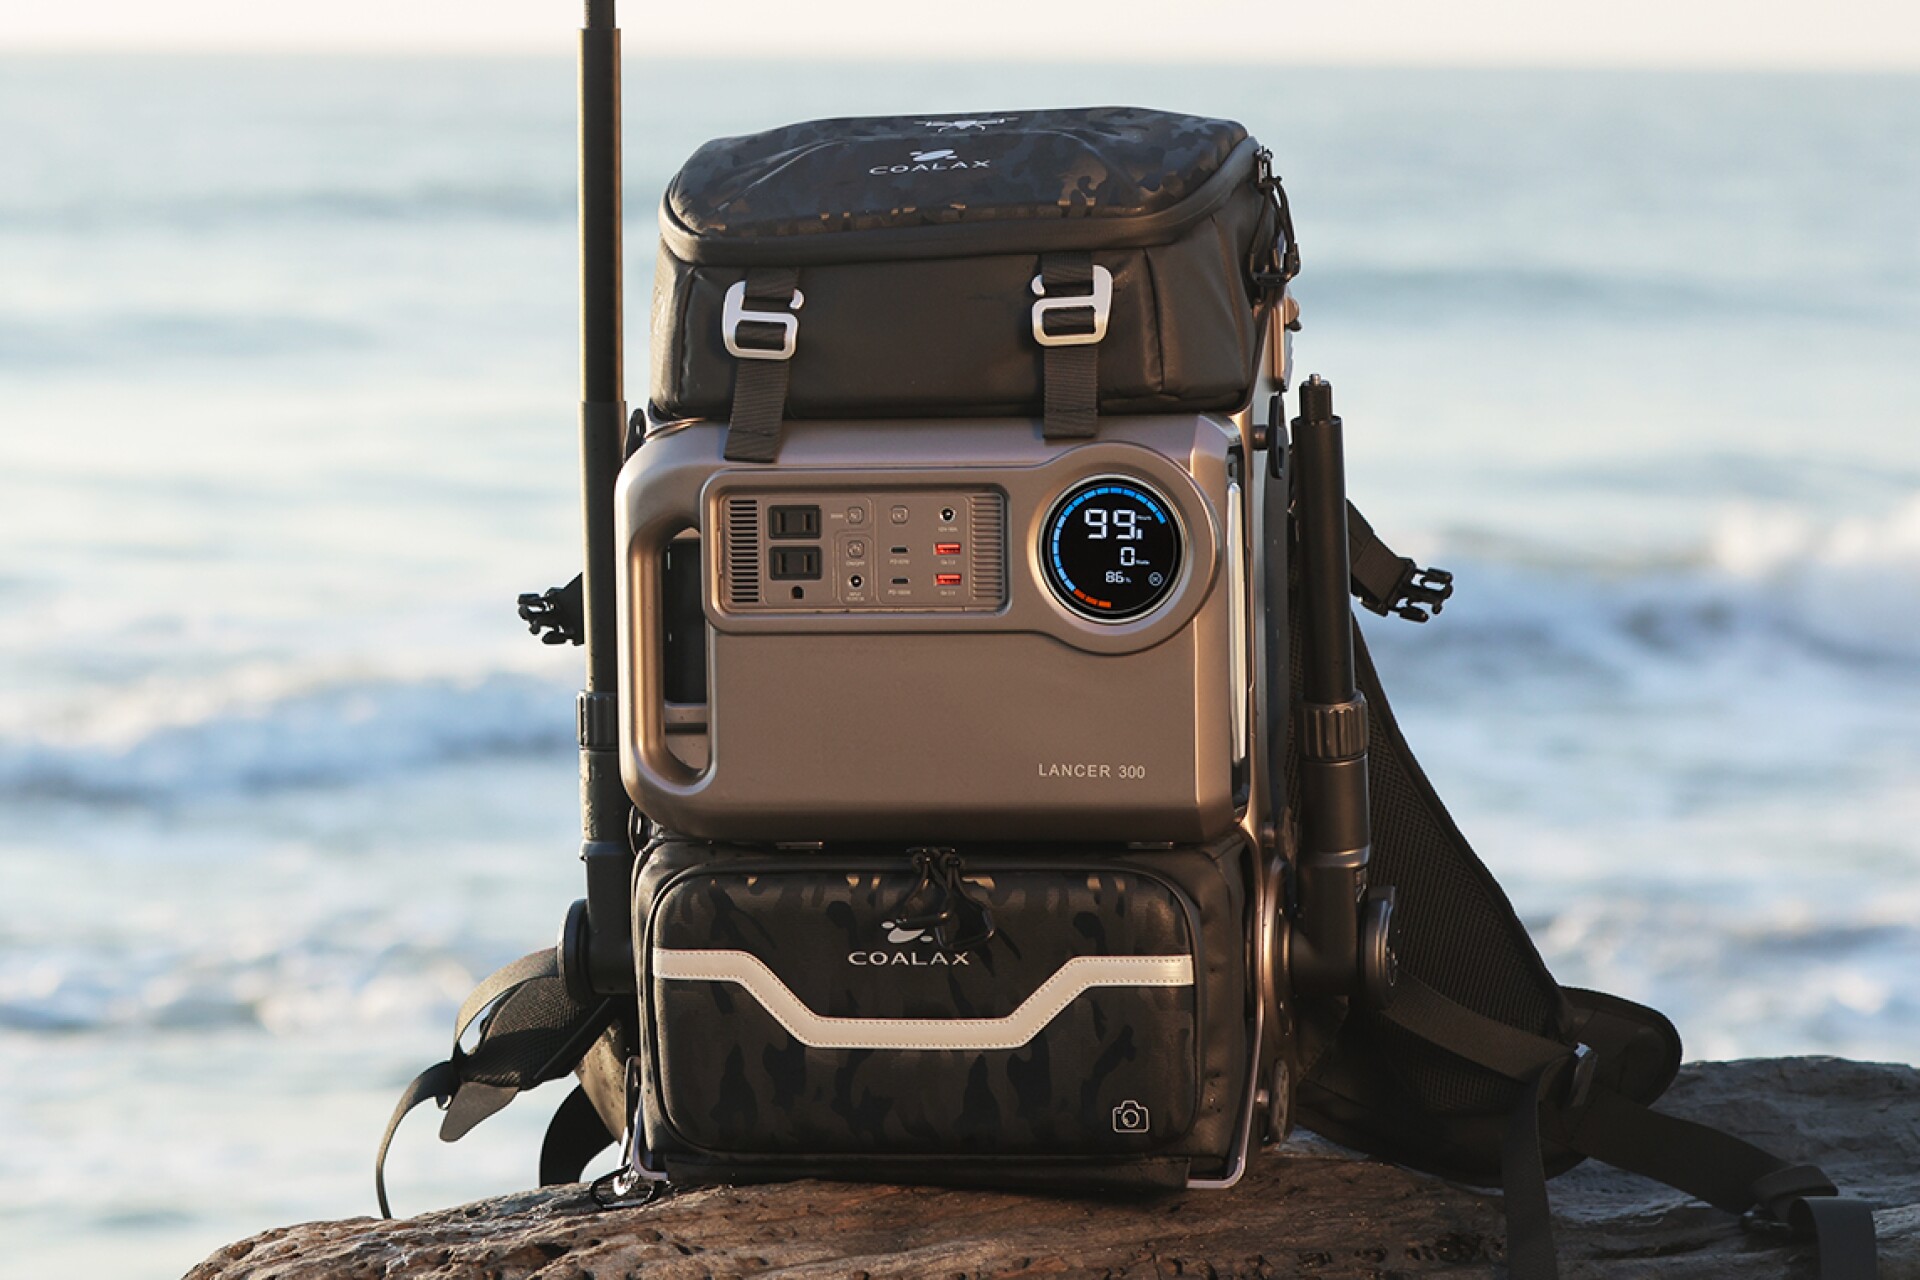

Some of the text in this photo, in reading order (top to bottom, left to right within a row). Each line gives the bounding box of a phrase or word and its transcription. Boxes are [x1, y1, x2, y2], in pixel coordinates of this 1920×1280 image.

[869, 160, 991, 175] COALAX
[1120, 546, 1135, 566] 0
[1038, 763, 1146, 779] LANCER 300
[848, 950, 970, 966] COALAX
